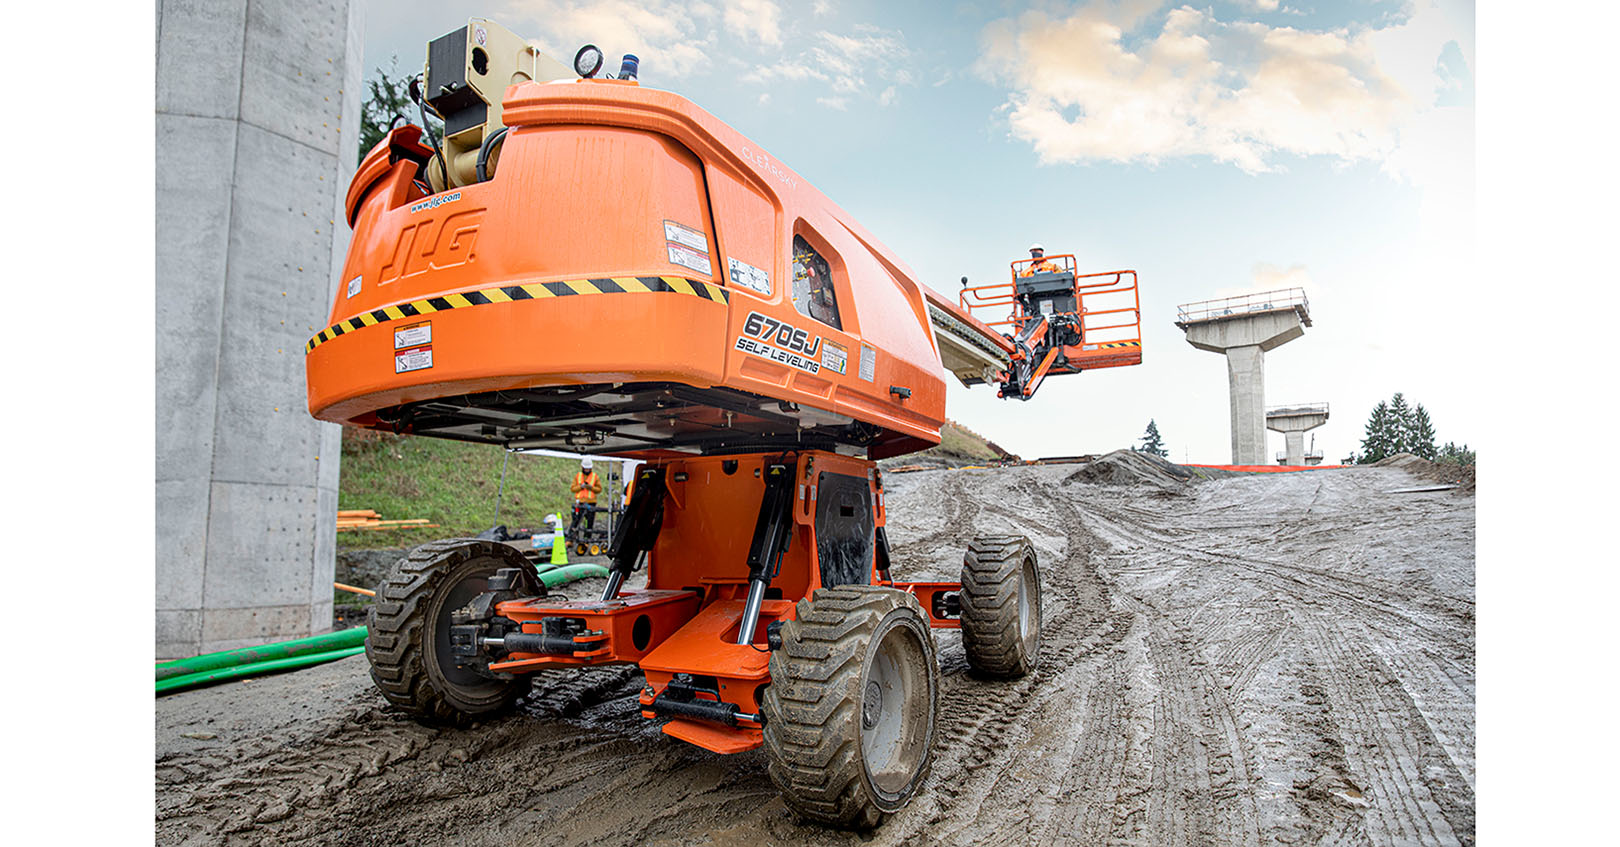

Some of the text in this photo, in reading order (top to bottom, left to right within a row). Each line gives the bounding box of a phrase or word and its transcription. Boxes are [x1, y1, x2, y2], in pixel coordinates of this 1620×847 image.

[742, 146, 797, 190] CLEARSKY
[411, 192, 461, 213] www.jlg.com
[744, 312, 820, 357] 670SJ
[737, 338, 769, 355] SELF
[770, 349, 819, 373] LEVELING
